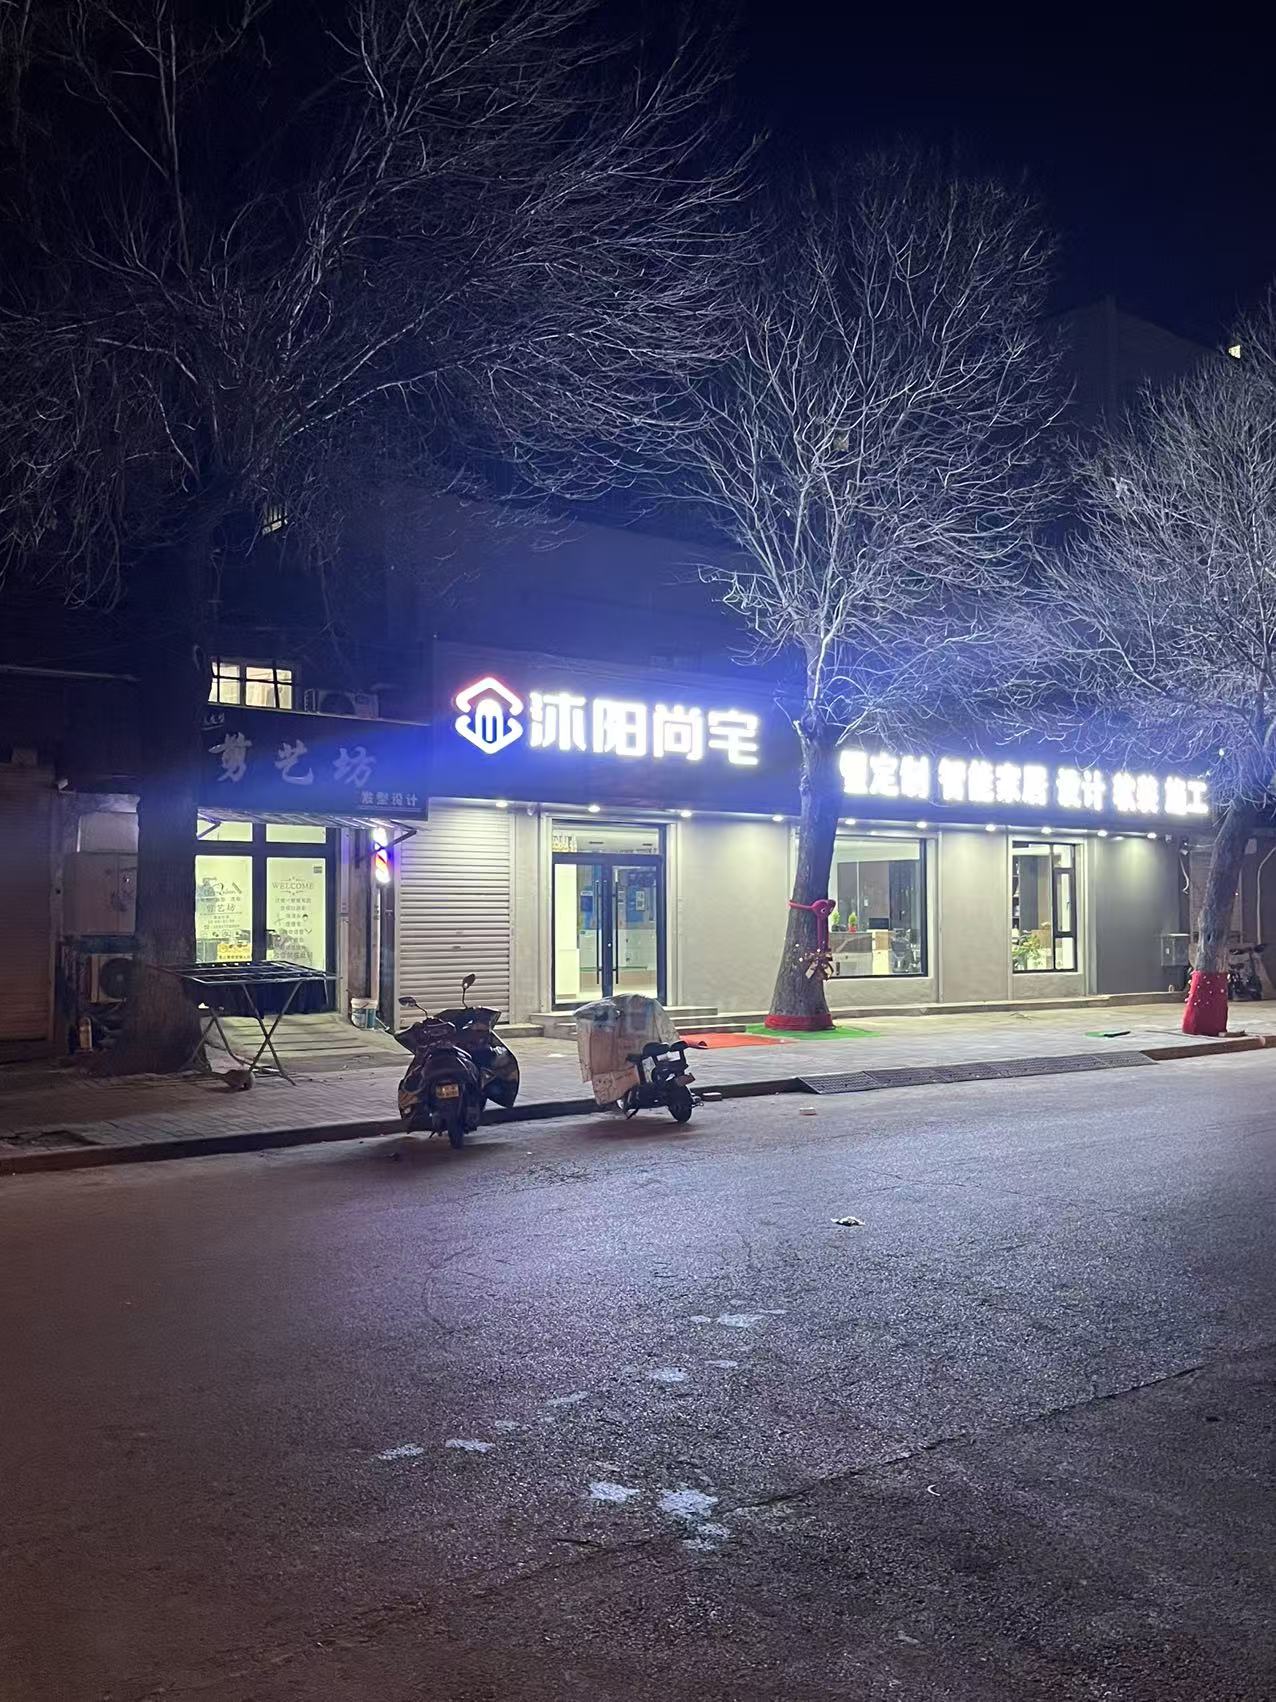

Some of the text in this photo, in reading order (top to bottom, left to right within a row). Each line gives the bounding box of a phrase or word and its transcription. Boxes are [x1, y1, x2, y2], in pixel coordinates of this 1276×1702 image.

[529, 692, 758, 766] 沐阳尚宅
[272, 881, 314, 890] WELCOME
